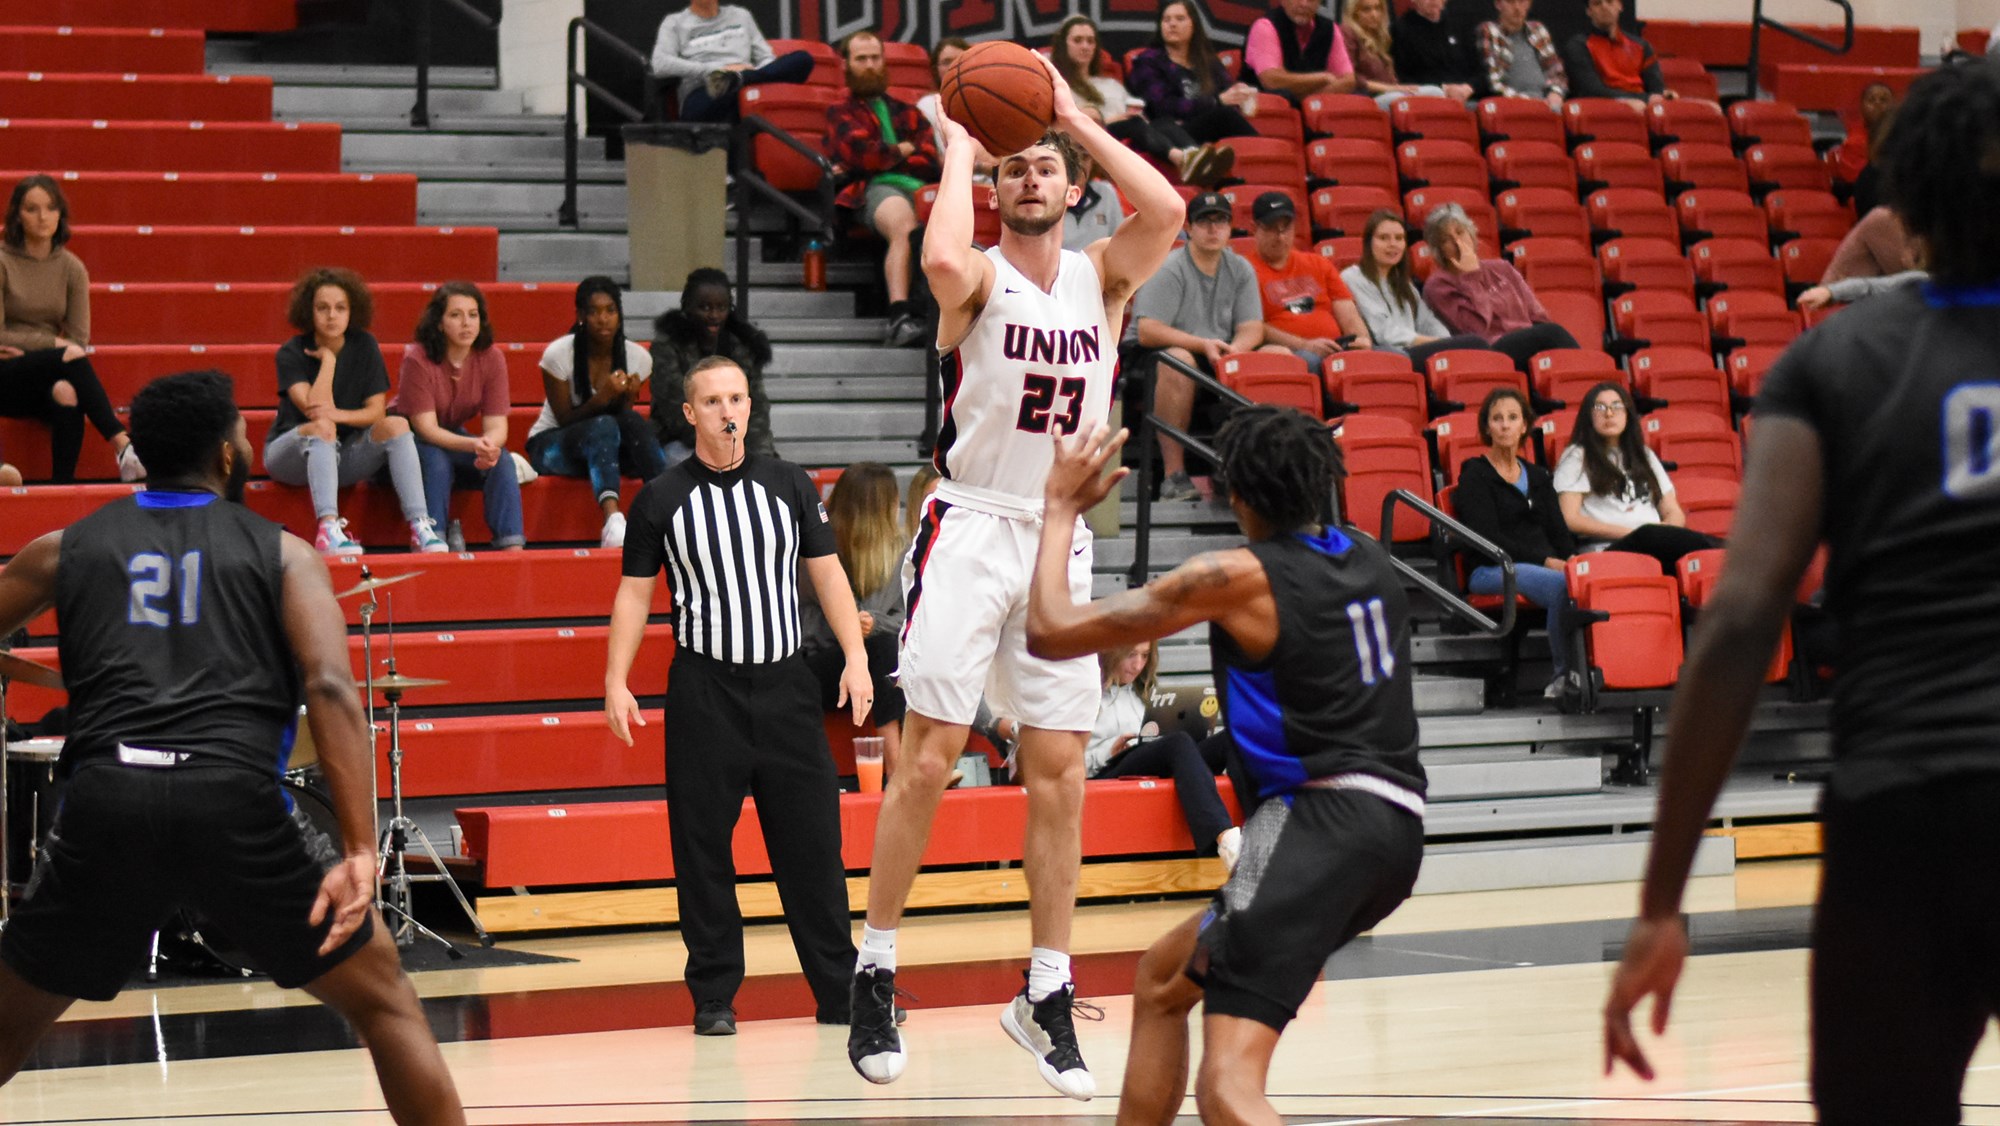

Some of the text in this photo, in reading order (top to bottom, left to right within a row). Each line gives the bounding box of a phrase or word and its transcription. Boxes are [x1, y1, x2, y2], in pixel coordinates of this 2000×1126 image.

[1003, 323, 1099, 365] UNION
[1016, 372, 1086, 437] 23
[128, 550, 202, 628] 21
[1345, 597, 1395, 685] 11
